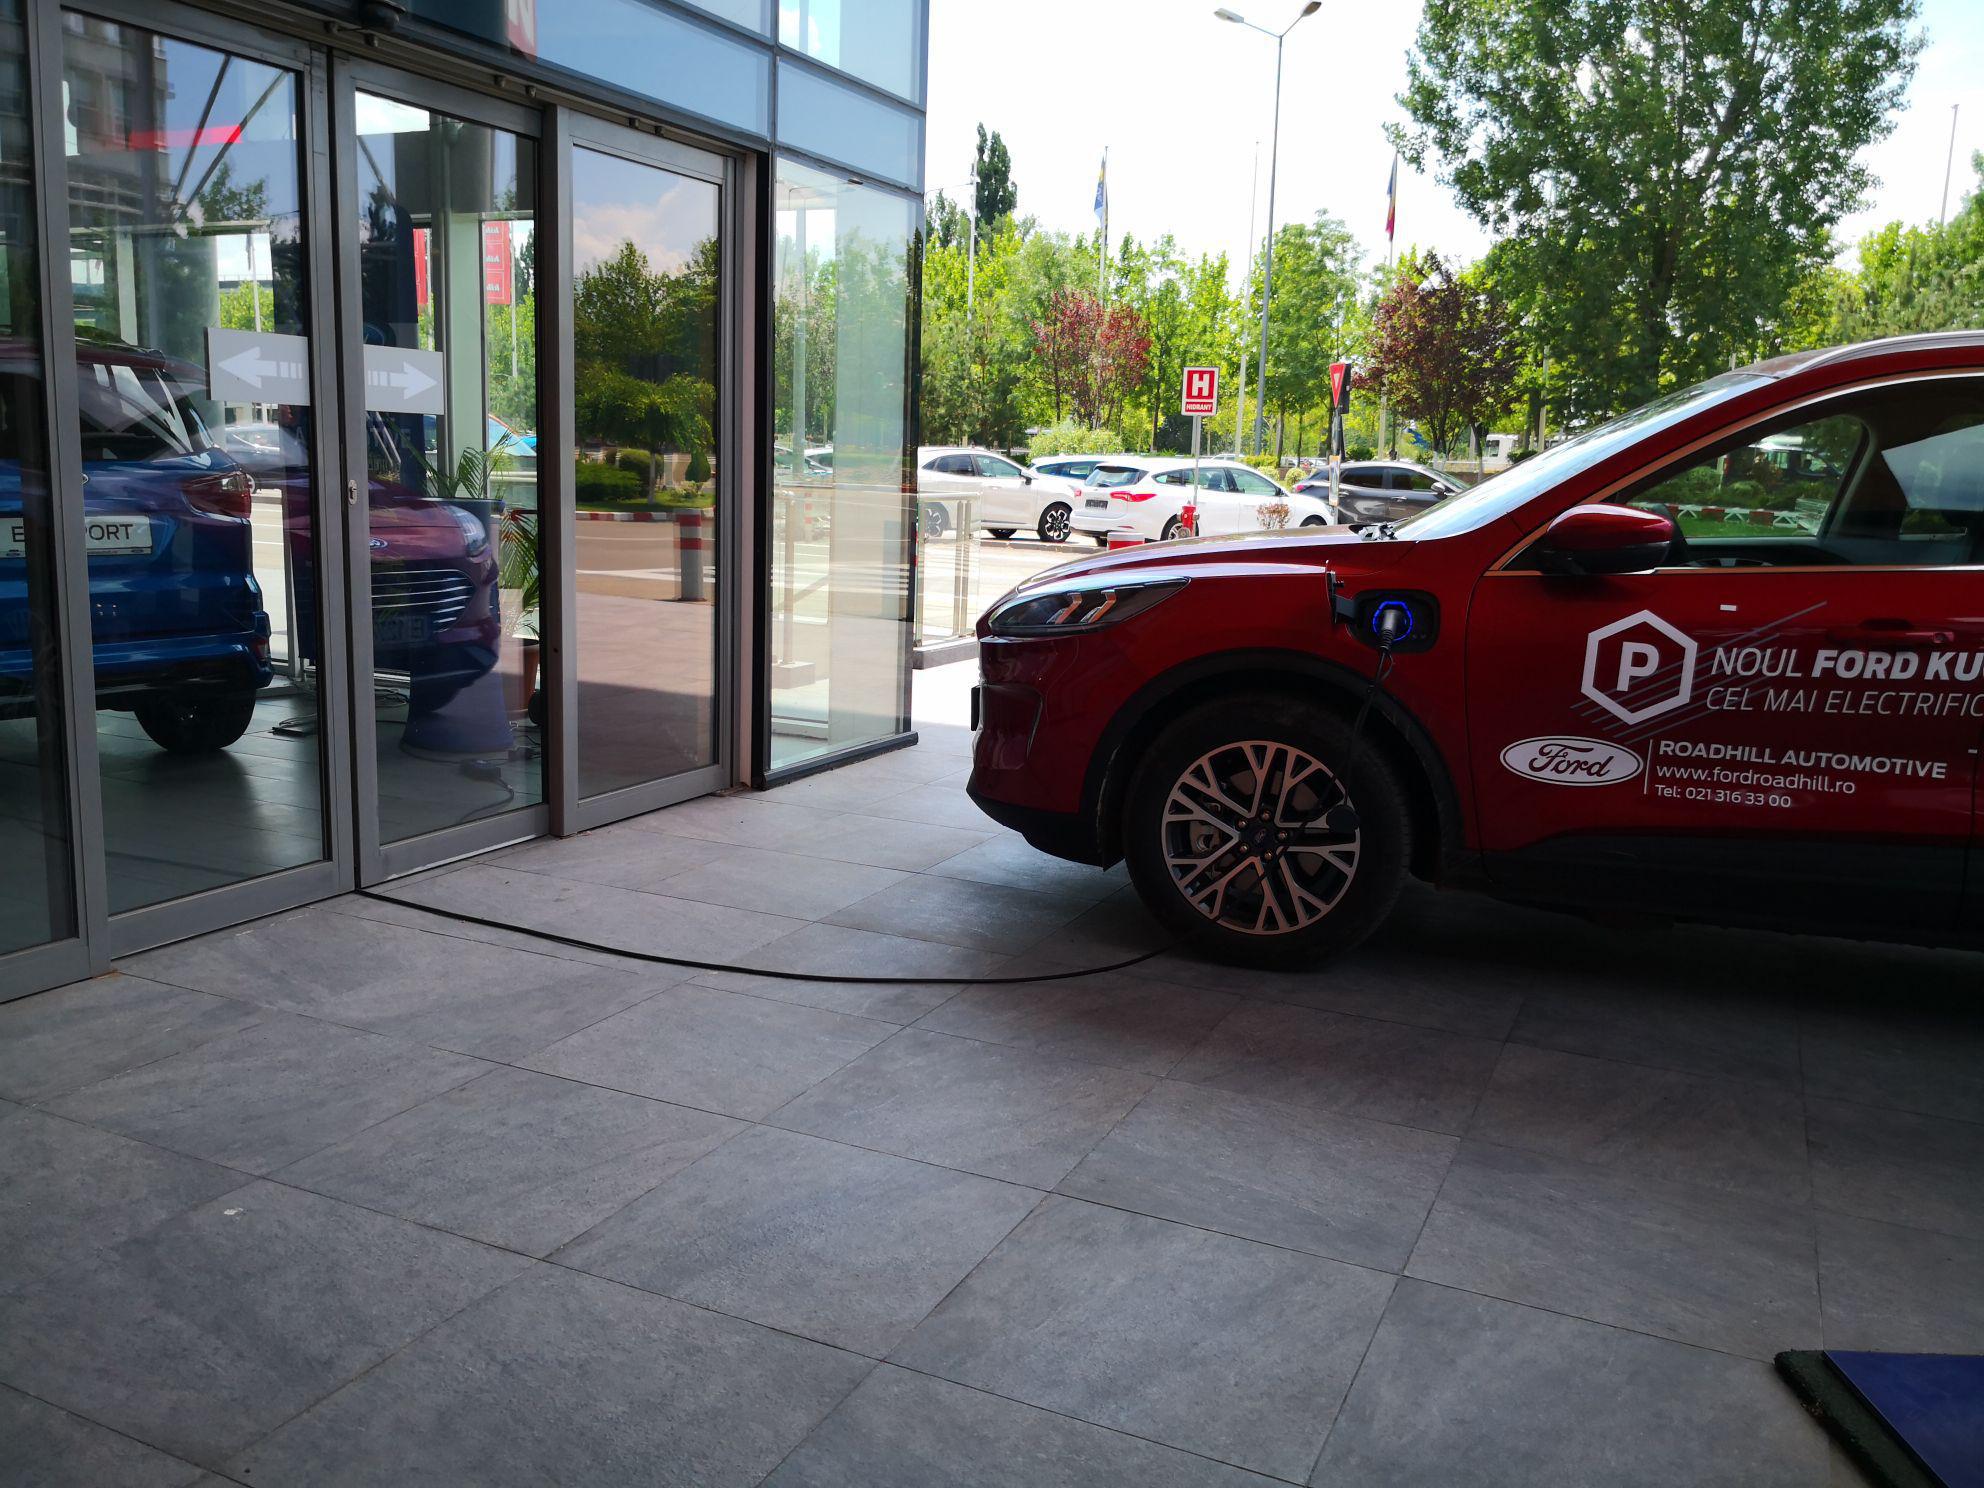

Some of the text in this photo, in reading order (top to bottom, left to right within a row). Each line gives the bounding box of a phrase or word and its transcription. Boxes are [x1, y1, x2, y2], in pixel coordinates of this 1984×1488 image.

[1191, 373, 1210, 397] H
[1186, 403, 1212, 411] HIDRANT
[1616, 641, 1660, 692] P
[1711, 647, 1984, 681] NOUL FORD KU
[1706, 687, 1984, 717] CEL MAI ELECTRIFIC
[1528, 743, 1614, 777] Ford
[1659, 740, 1948, 779] ROADHILL AUTOMOTIVE
[1656, 765, 1856, 794] www.fordroadhill.ro
[1655, 784, 1791, 808] Tel: 021 316 33 00
